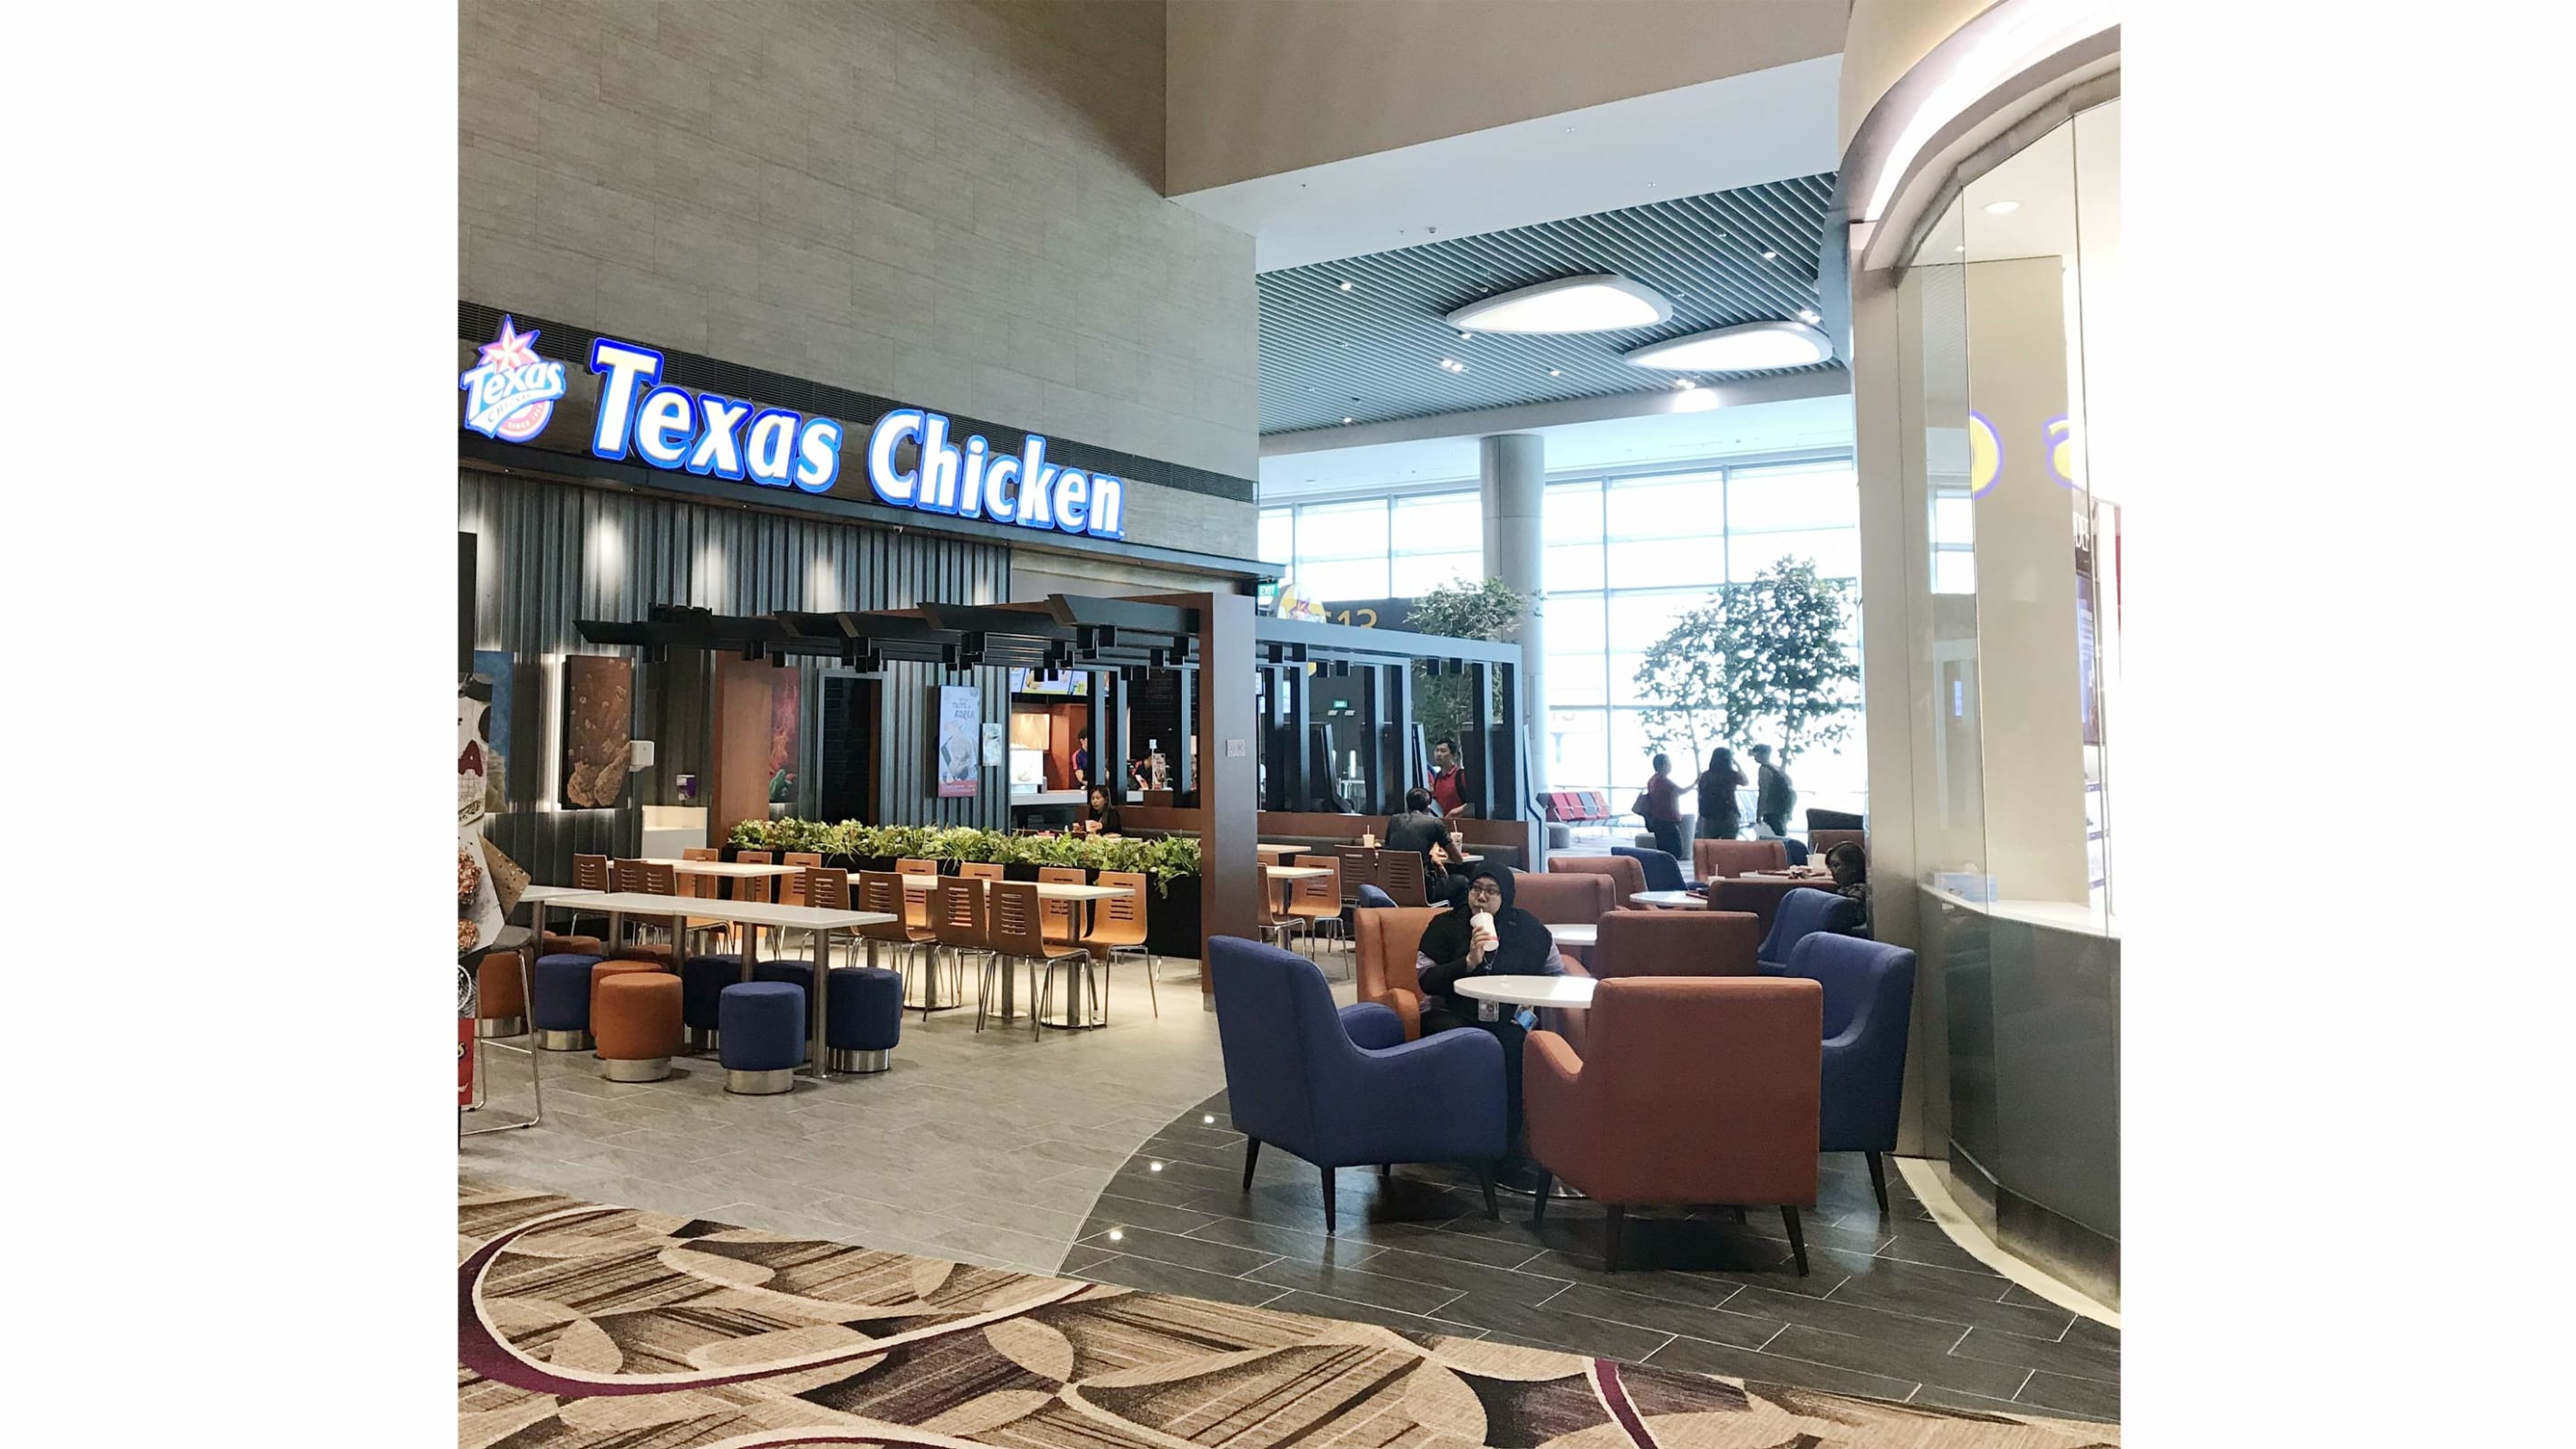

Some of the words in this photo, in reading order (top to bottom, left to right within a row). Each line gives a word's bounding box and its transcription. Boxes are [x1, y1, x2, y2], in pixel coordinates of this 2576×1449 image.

[462, 361, 562, 422] Texas
[591, 341, 841, 491] Texas
[870, 410, 1123, 538] Chicken
[1259, 585, 1276, 595] EXIT
